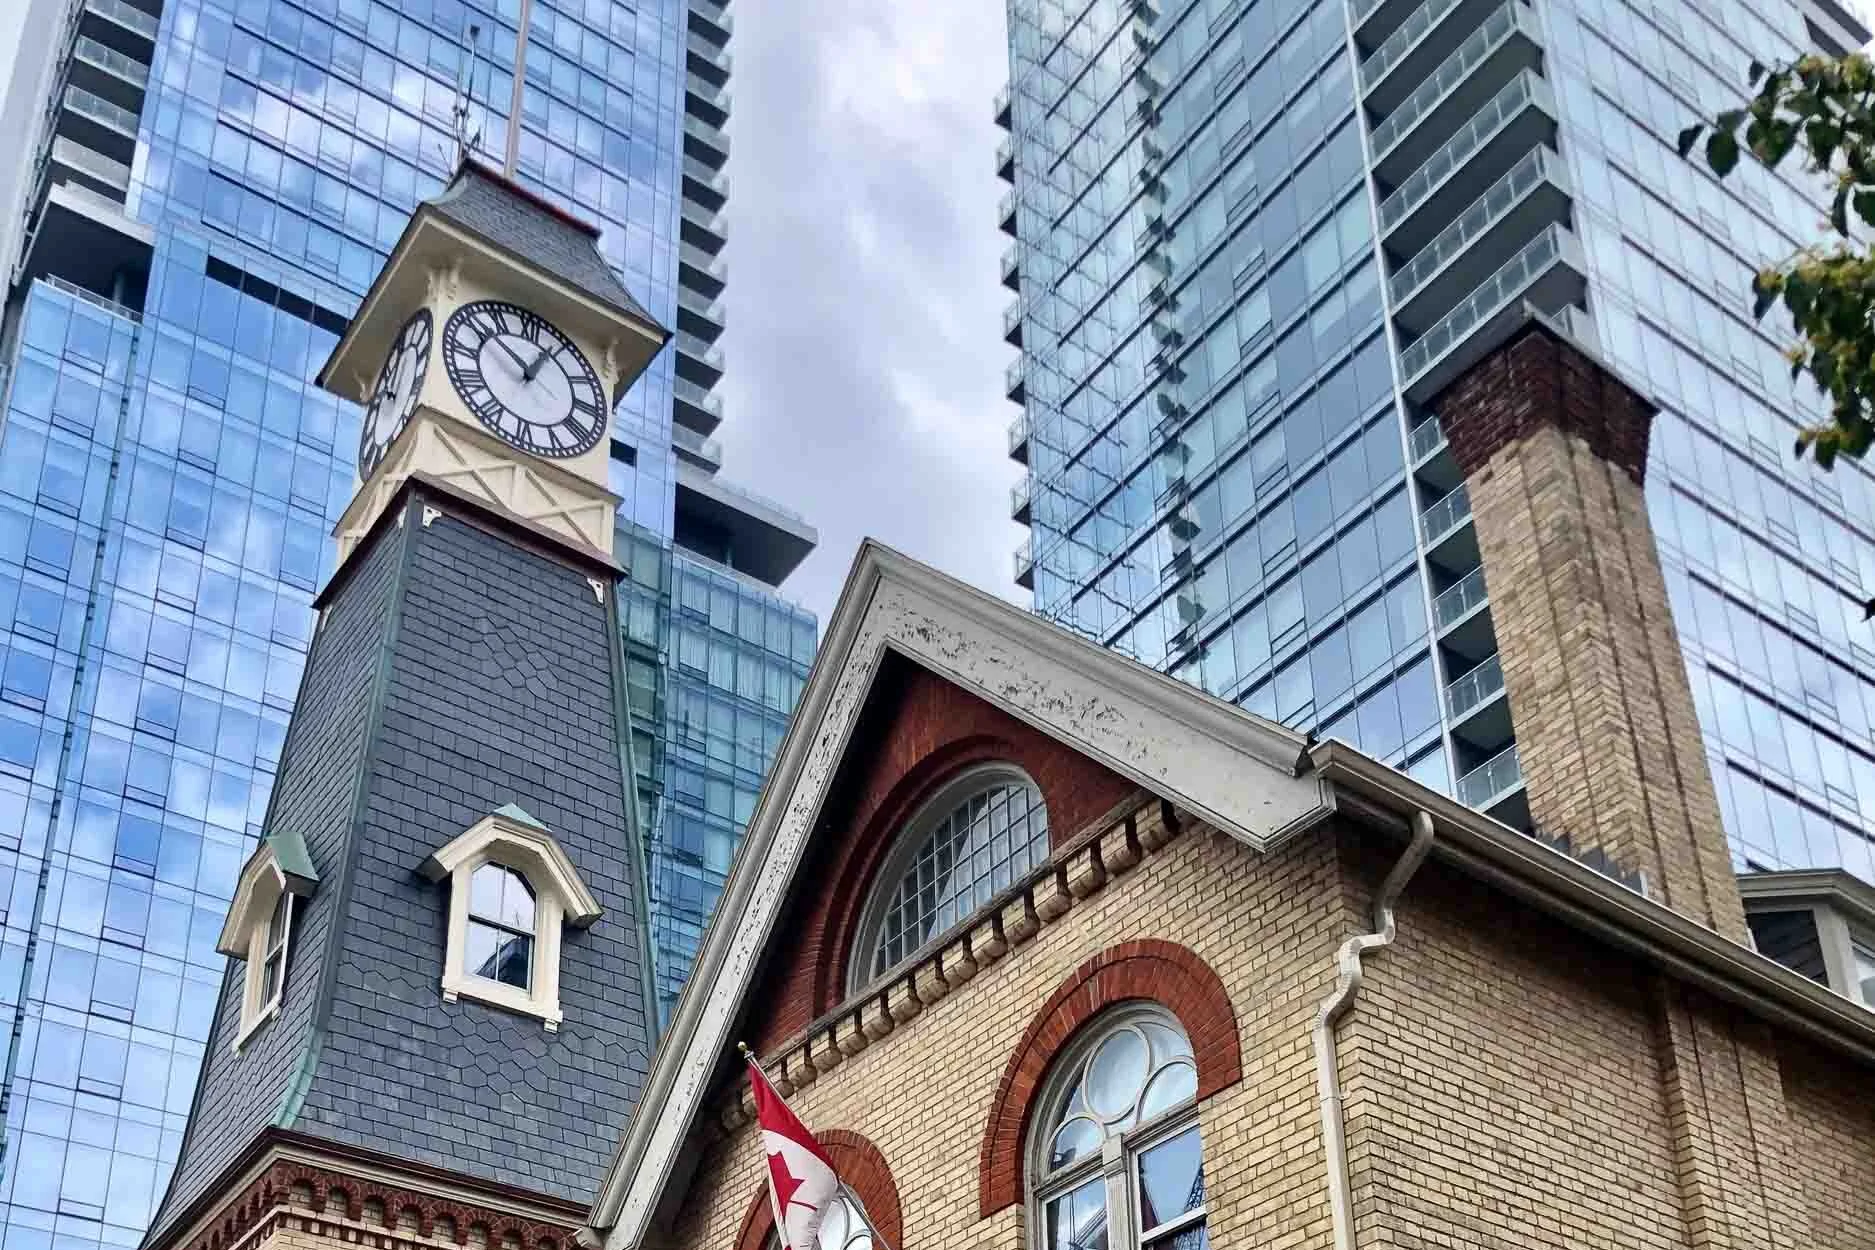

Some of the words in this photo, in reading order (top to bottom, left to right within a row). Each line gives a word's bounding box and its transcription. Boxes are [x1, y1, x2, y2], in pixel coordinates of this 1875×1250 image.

[519, 312, 540, 345] XII
[568, 376, 592, 384] II
[480, 397, 505, 428] VII
[574, 398, 598, 418] III
[516, 421, 533, 448] VI
[547, 426, 564, 448] V
